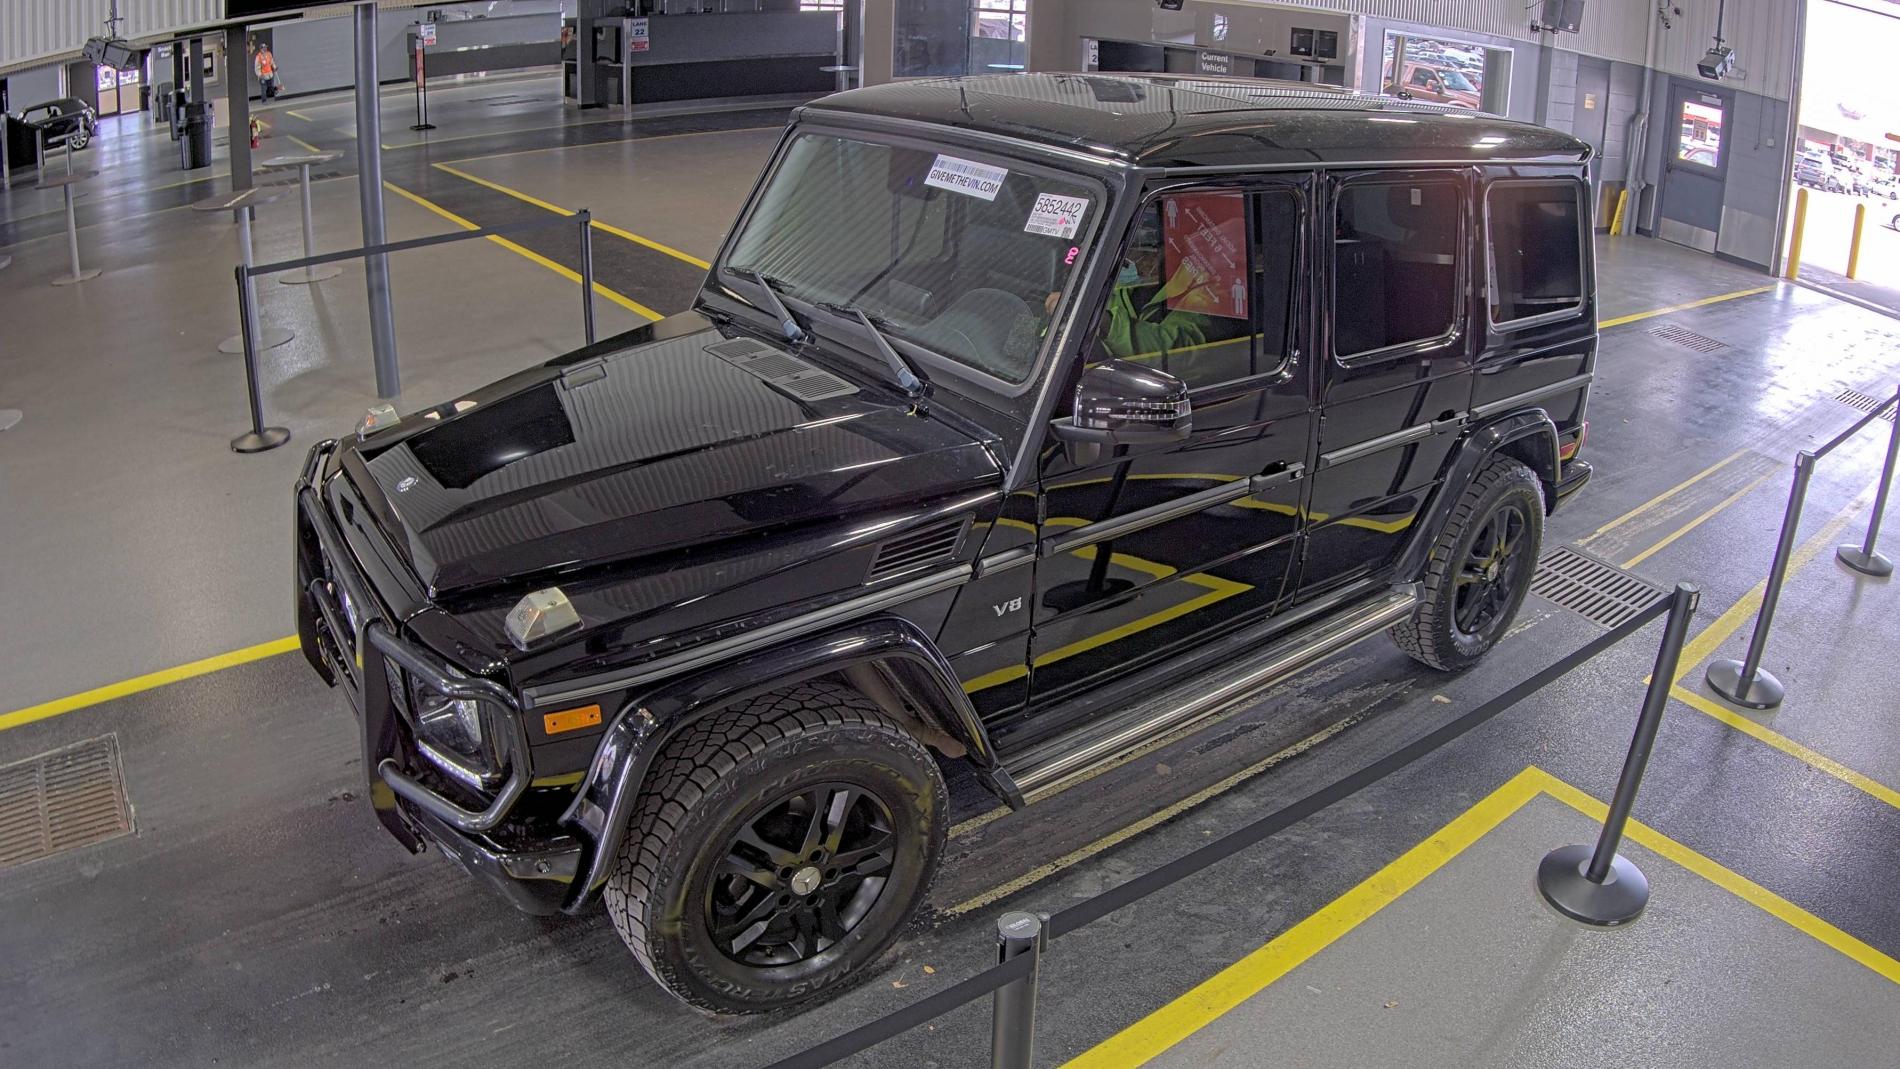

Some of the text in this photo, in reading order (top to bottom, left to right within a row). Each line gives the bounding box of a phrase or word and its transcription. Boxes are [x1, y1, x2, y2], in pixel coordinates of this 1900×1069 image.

[1201, 52, 1229, 63] Current
[1201, 62, 1227, 74] Vehicle
[930, 169, 1000, 194] GIVEMETHEVIN.COM
[1035, 197, 1082, 218] 5852442
[992, 597, 1022, 617] V8
